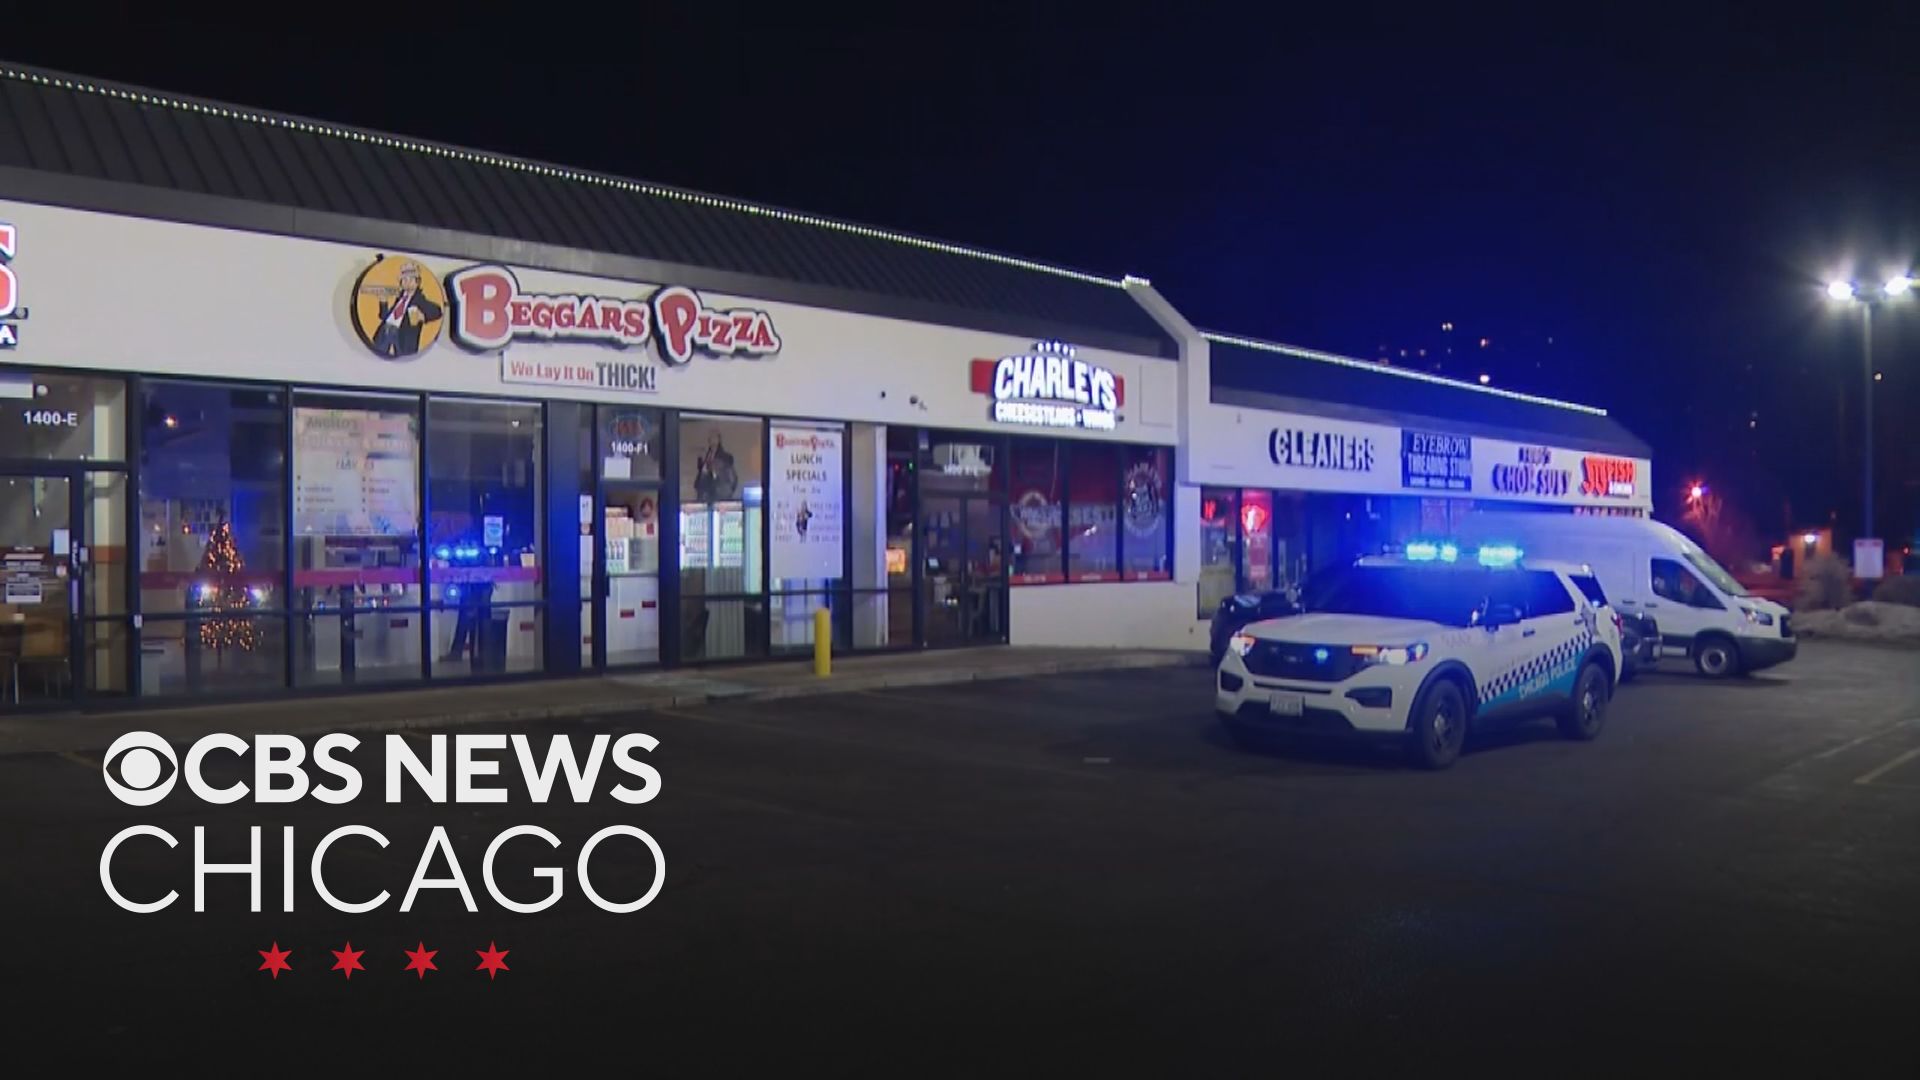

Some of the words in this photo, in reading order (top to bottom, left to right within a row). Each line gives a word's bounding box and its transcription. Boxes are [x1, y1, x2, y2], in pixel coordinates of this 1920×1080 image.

[457, 270, 649, 343] BEGGARS
[658, 292, 777, 357] PIZZA
[511, 360, 533, 376] We
[537, 362, 560, 381] Lay
[564, 365, 573, 380] It
[577, 366, 594, 381] On
[596, 362, 656, 390] THICK!
[994, 355, 1117, 411] CHARLEYS
[24, 410, 78, 427] 1400-E
[611, 440, 649, 456] 1400-F1
[1269, 428, 1374, 472] CLEANERS
[1413, 432, 1470, 456] EYEBROW
[791, 453, 823, 465] LUNCH
[786, 469, 828, 482] SPECIALS
